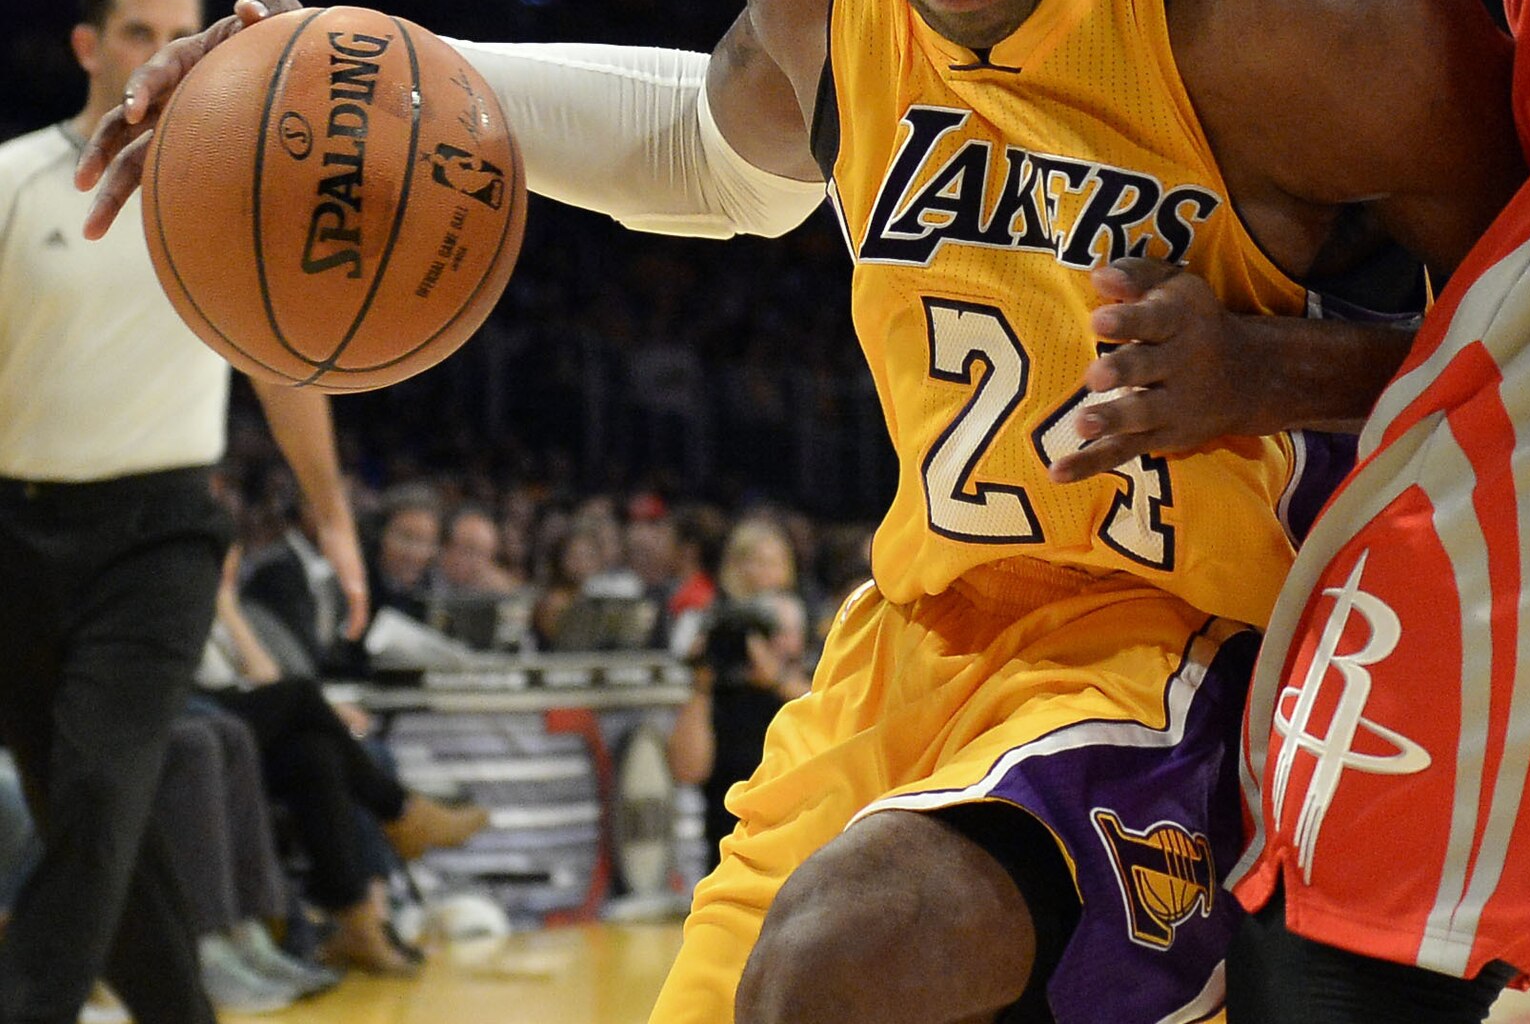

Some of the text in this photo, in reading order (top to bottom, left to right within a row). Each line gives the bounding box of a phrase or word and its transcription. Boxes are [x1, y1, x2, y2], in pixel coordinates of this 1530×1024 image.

[302, 31, 393, 279] SPALDING
[858, 105, 1222, 270] LAKERS
[415, 261, 445, 299] OFFICIAL
[438, 232, 459, 258] GAME
[451, 205, 468, 230] BALL
